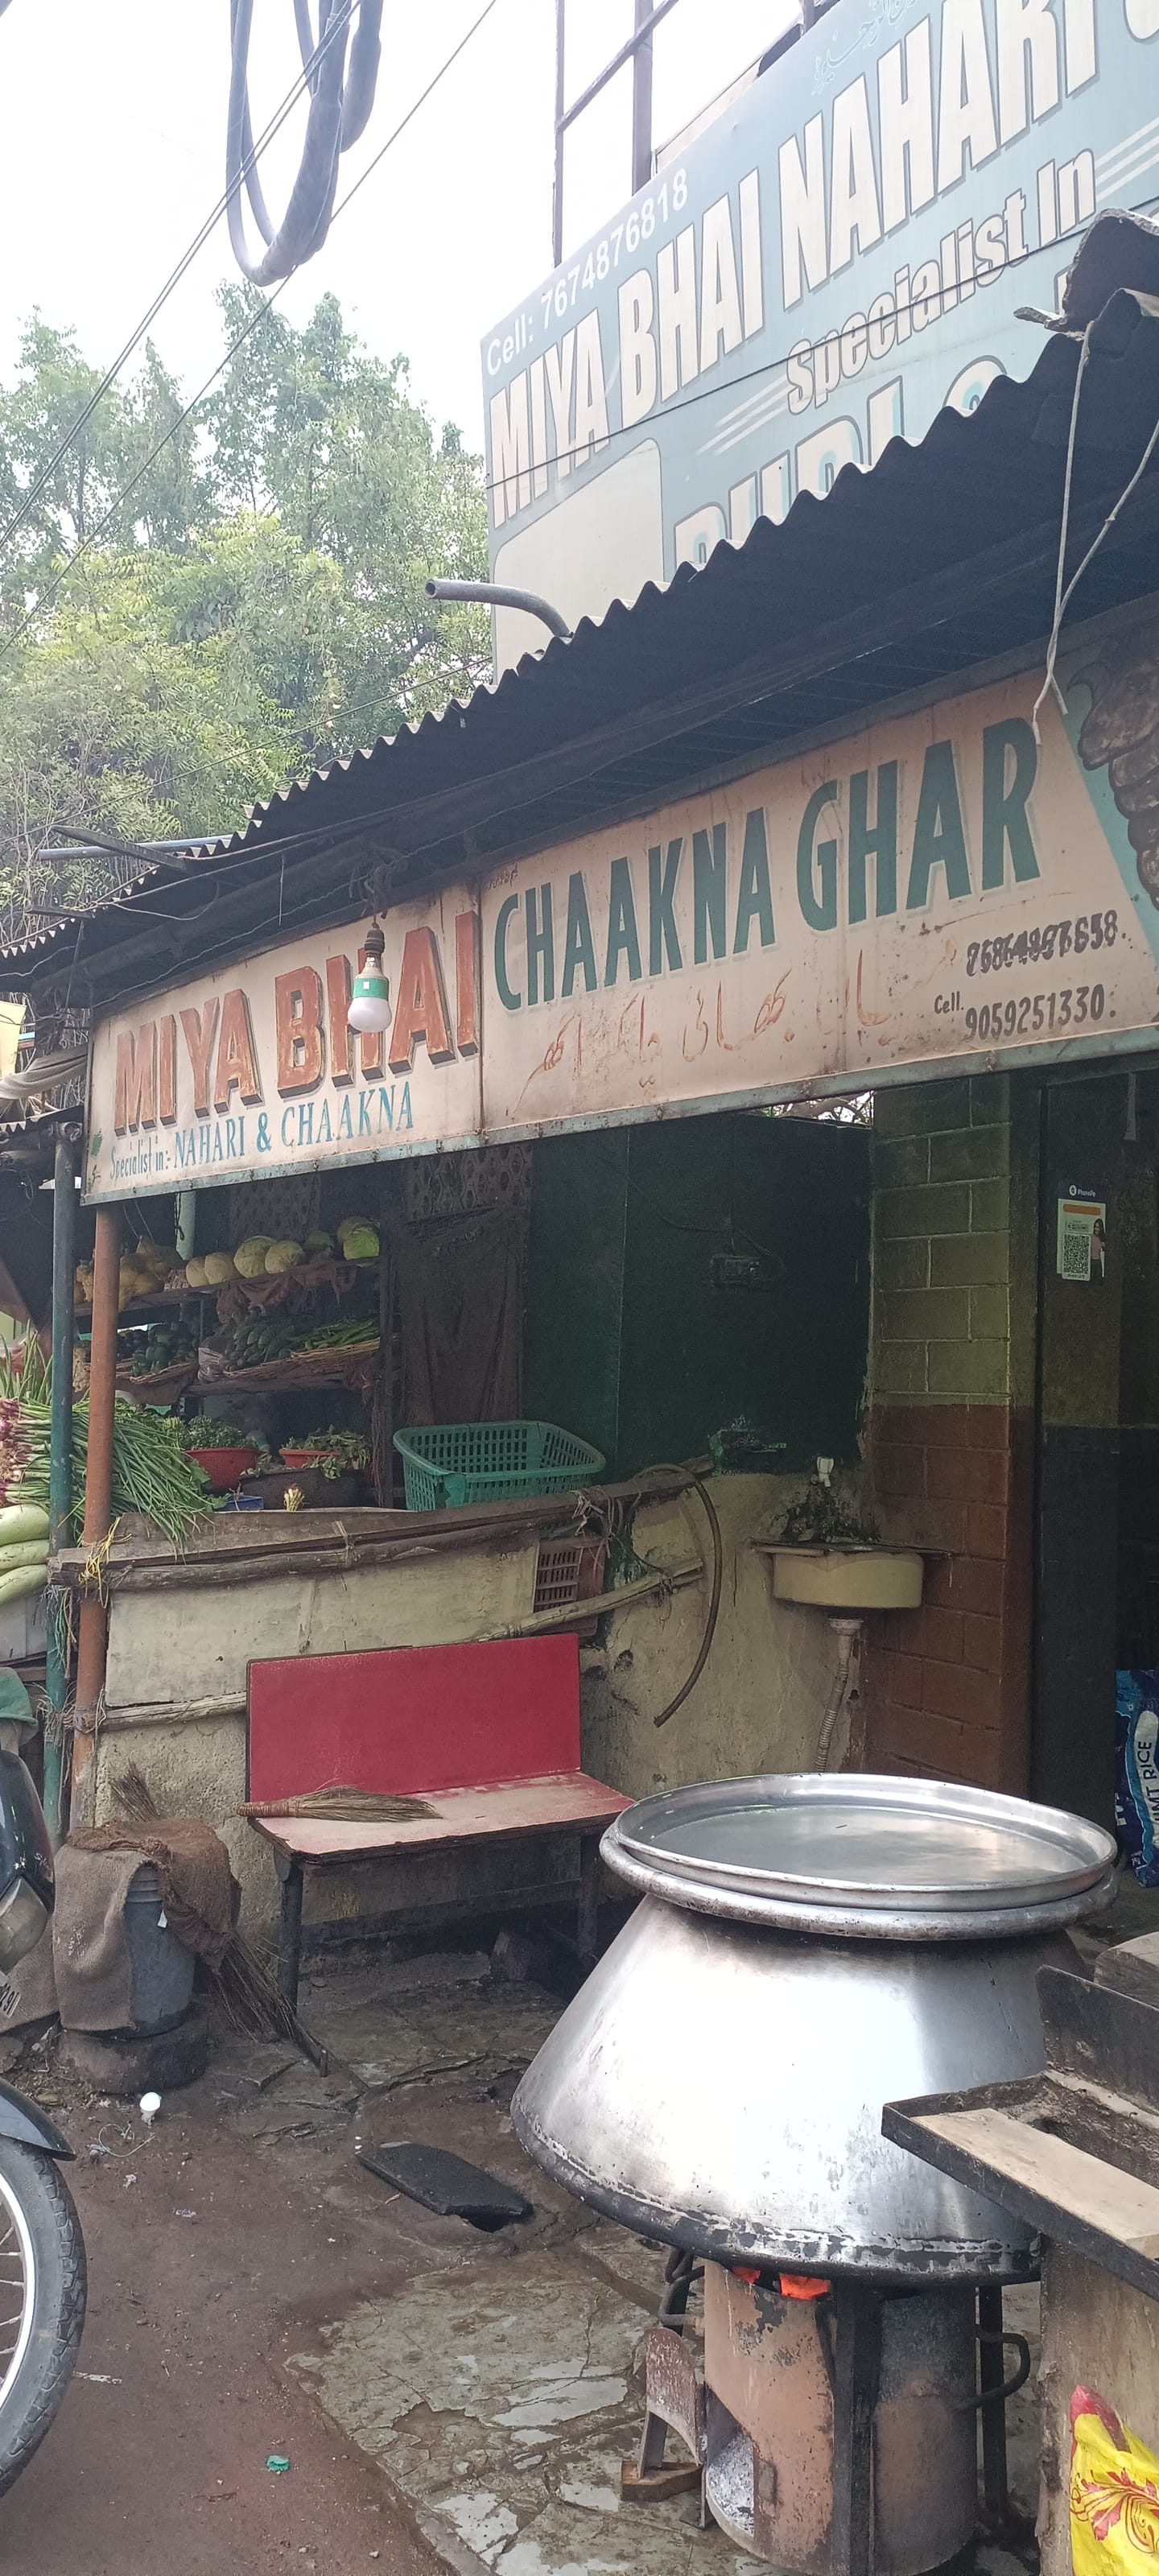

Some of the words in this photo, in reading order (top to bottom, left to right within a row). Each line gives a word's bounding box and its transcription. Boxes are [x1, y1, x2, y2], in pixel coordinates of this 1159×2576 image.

[487, 313, 534, 375] Cell:
[541, 167, 689, 330] 7674876818
[1037, 149, 1098, 247] In
[489, 308, 609, 529] MIYA
[617, 167, 765, 428] BHAI
[493, 807, 776, 1012] CHAAKNA
[797, 718, 1041, 931] GHAR
[114, 989, 262, 1136] MIYA
[275, 910, 480, 1099] BHAI
[110, 1137, 153, 1180] Specialist
[173, 1116, 246, 1169] NAHARI
[256, 1112, 273, 1153] &
[280, 1082, 415, 1146] CHAAKNA
[1138, 1740, 1158, 1780] RICE
